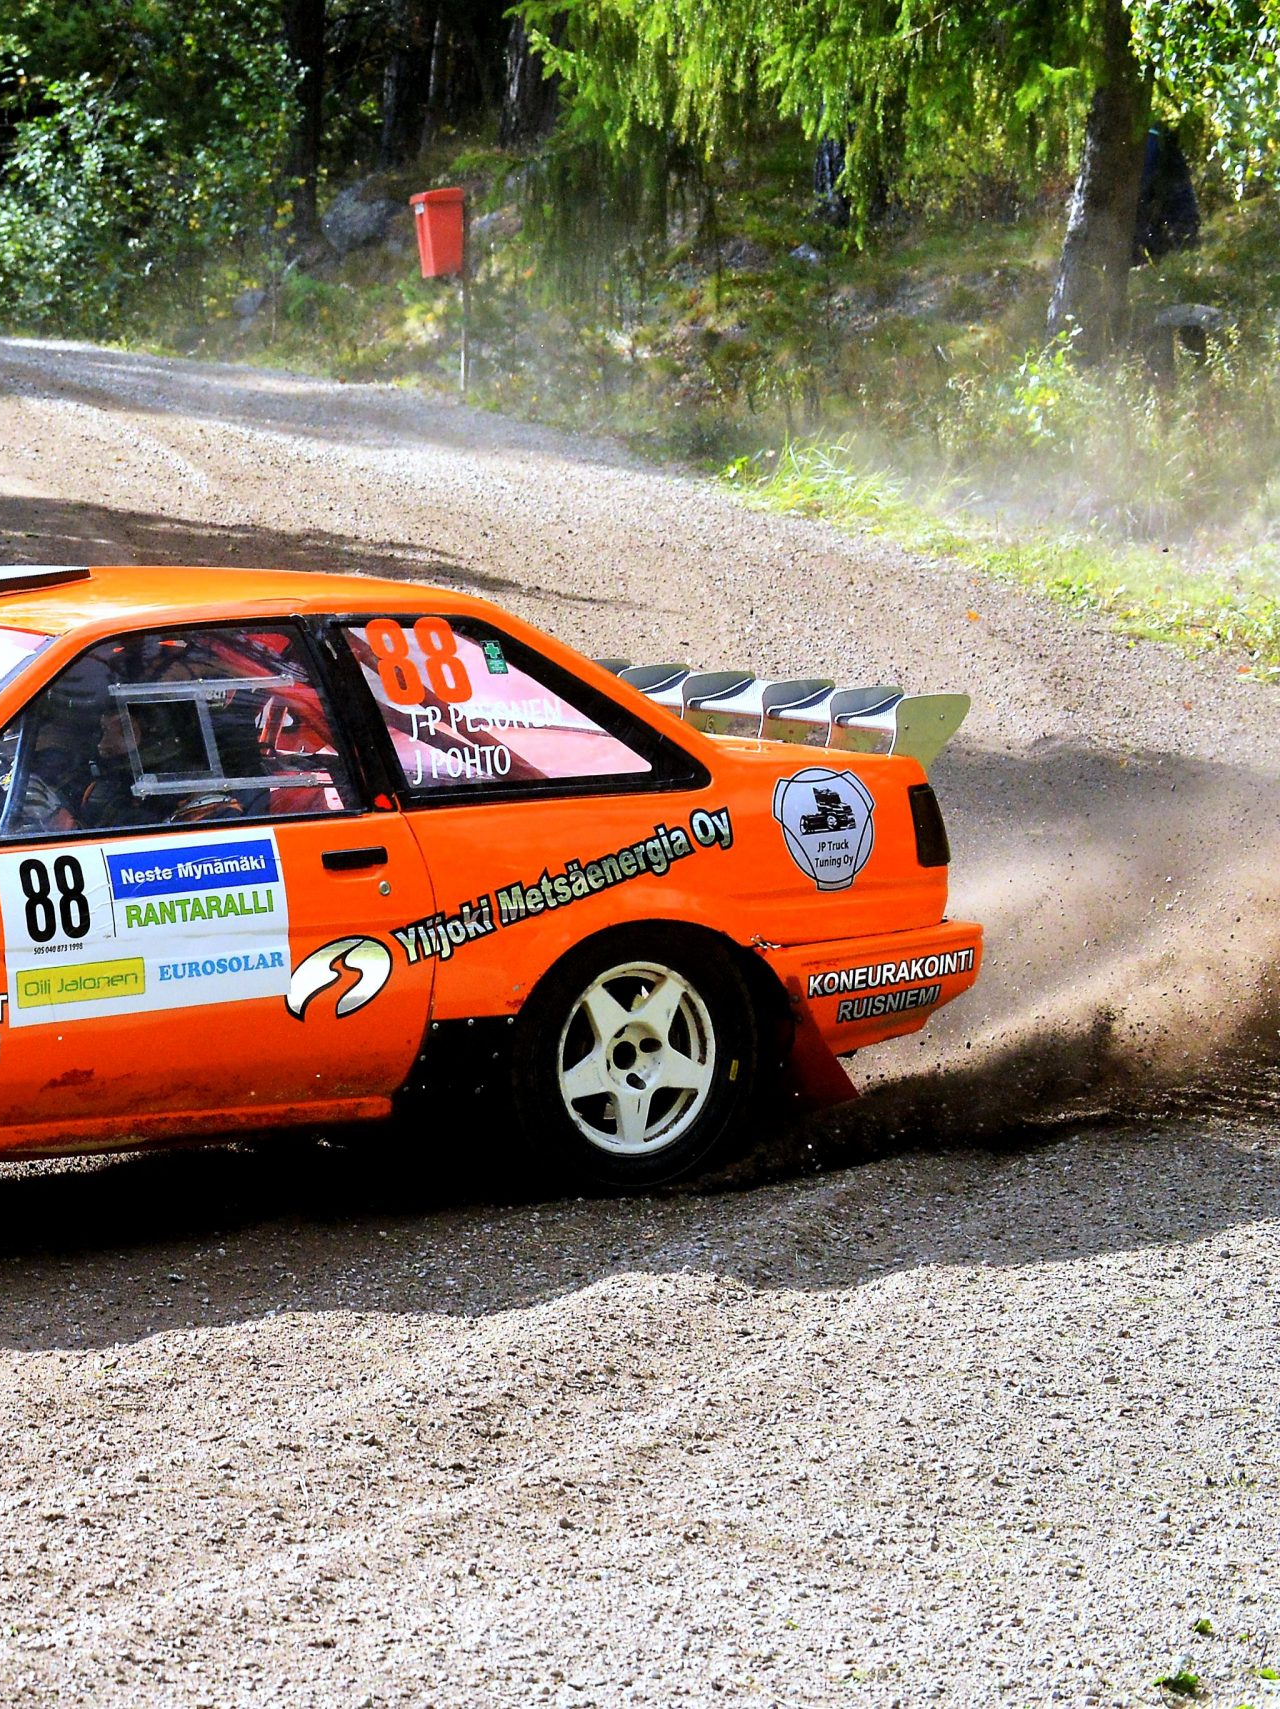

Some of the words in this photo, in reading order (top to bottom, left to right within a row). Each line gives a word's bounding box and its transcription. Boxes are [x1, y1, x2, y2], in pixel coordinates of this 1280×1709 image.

[365, 617, 473, 705] 88
[448, 698, 561, 734] PESONEN
[412, 749, 423, 785] J
[429, 744, 512, 779] POHTO
[814, 855, 842, 868] Tuning
[843, 854, 854, 867] Oy
[817, 841, 827, 853] JP
[827, 838, 849, 851] Truck
[120, 867, 173, 885] Neste
[177, 855, 266, 882] Mynämäki
[391, 896, 497, 964] Ylijoki
[497, 824, 695, 926] Metsäenergia
[690, 807, 734, 849] Oy
[19, 855, 91, 942] 88
[125, 889, 275, 929] RANTARALLI
[33, 947, 45, 955] SOS
[158, 951, 285, 981] EUROSOLAR
[57, 972, 138, 993] Jalonen
[806, 947, 975, 998] KONEURAKOINTI
[836, 985, 942, 1023] RUISNIEMI
